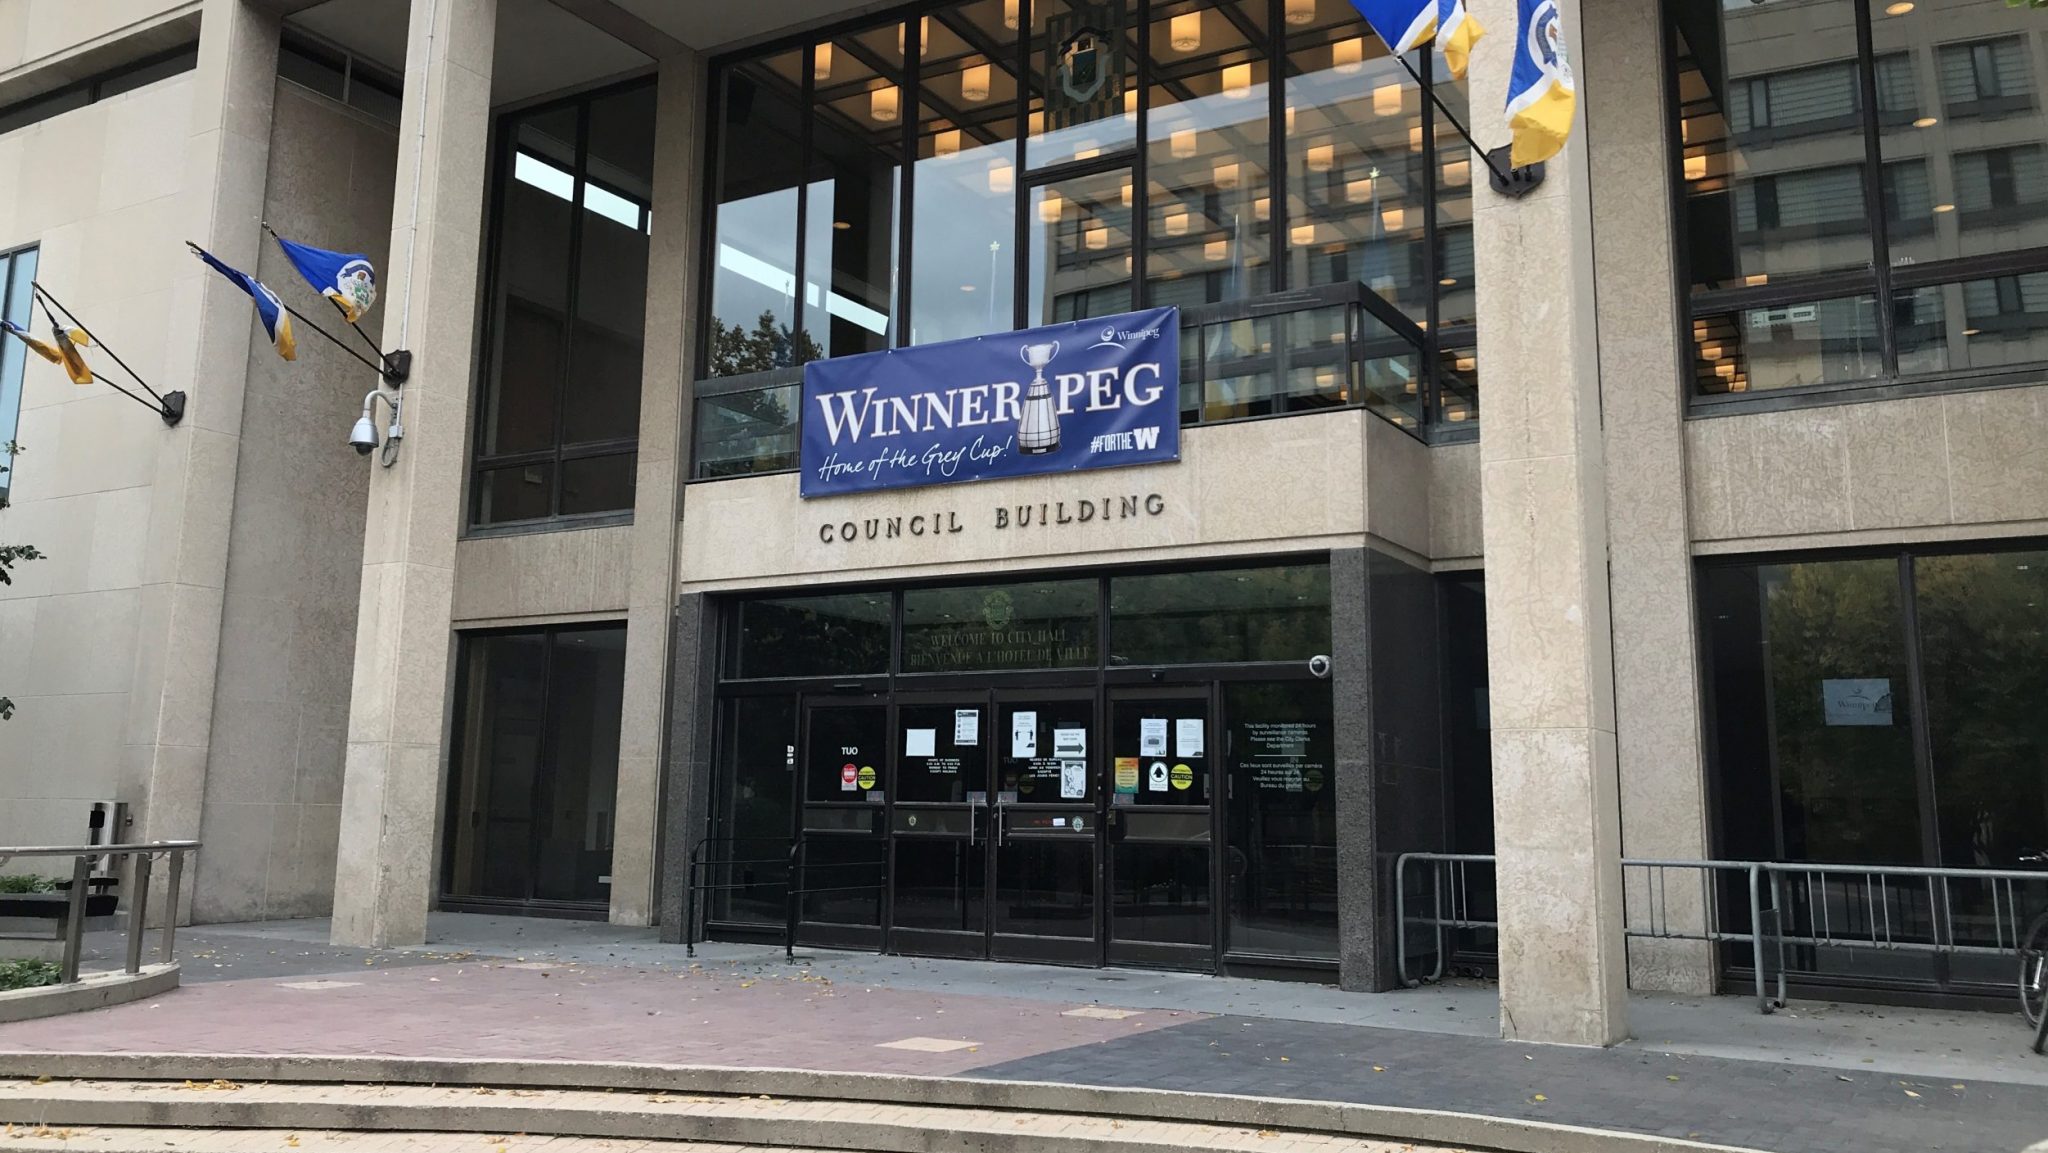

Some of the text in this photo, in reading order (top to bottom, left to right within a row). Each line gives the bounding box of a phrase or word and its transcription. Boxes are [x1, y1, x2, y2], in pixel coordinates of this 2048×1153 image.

[1117, 327, 1160, 340] Winnipeg
[815, 363, 1164, 446] WINNER PEG
[818, 435, 1013, 482] Home of the Grey Cup!
[819, 493, 1165, 543] COUNCIL BUILDING
[930, 629, 1067, 647] WELCOME TO CITY HALL
